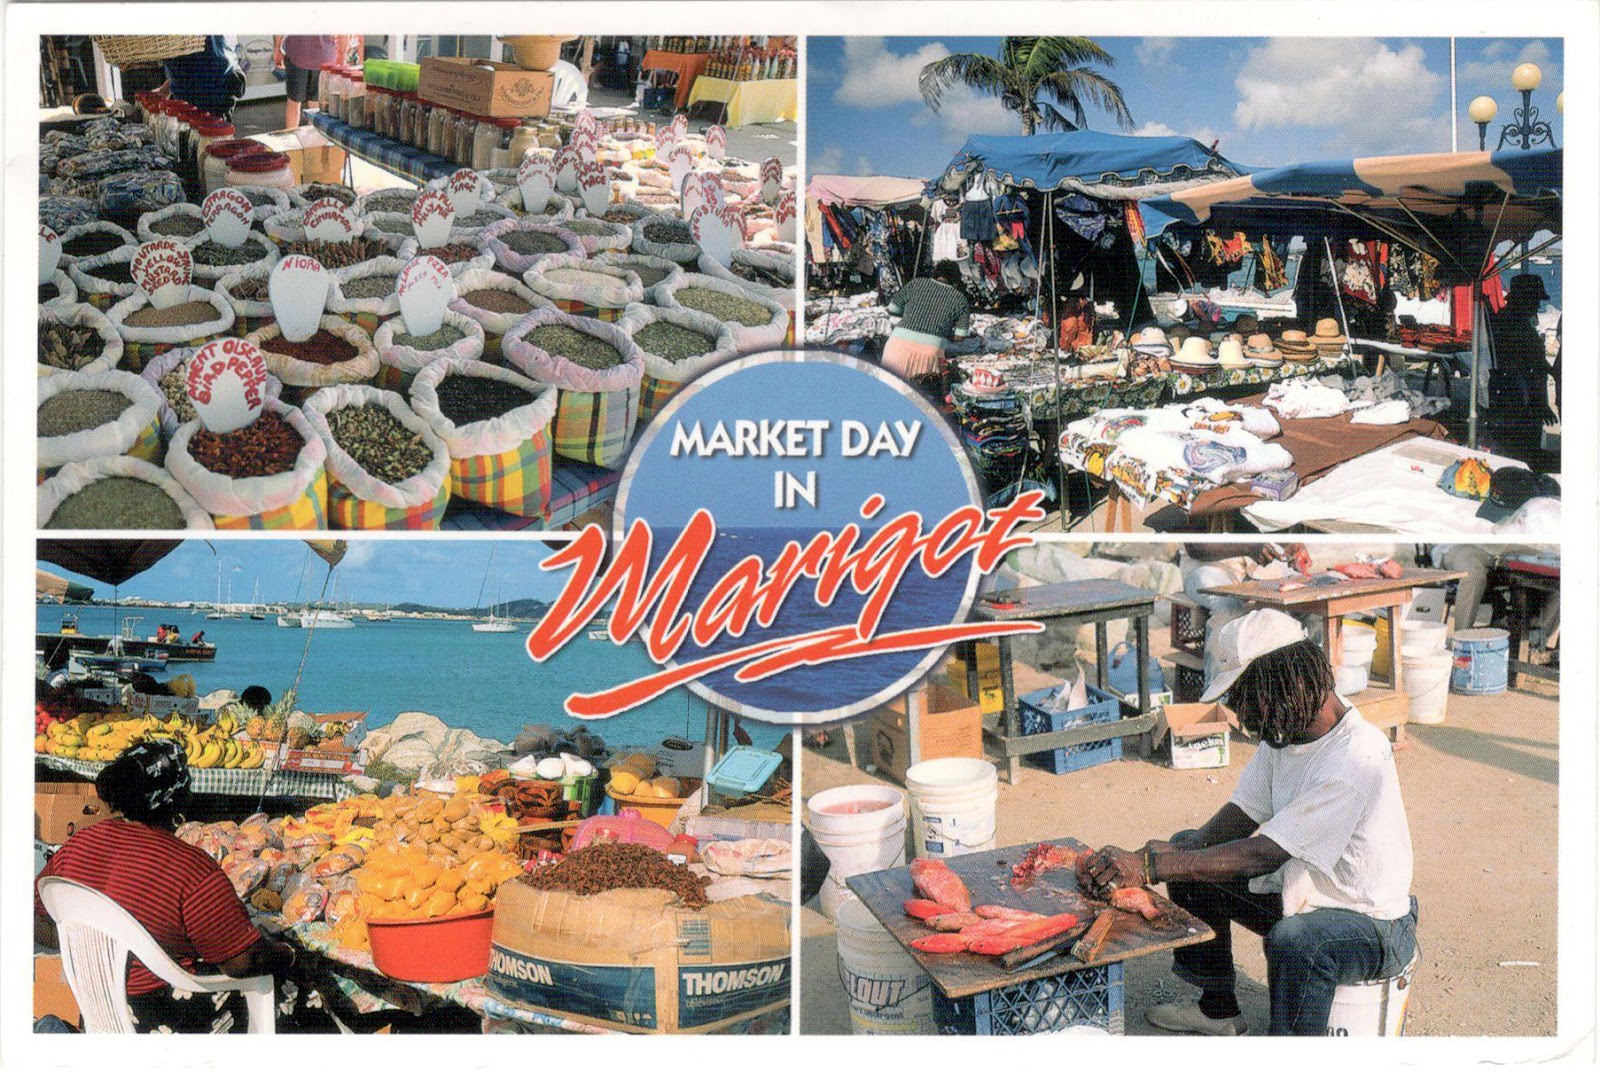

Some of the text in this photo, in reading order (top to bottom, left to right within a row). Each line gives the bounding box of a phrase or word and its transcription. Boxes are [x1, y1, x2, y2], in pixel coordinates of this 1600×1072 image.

[201, 189, 252, 218] ESTRAGON
[199, 361, 226, 405] BIRD
[682, 964, 785, 996] THOMSON
